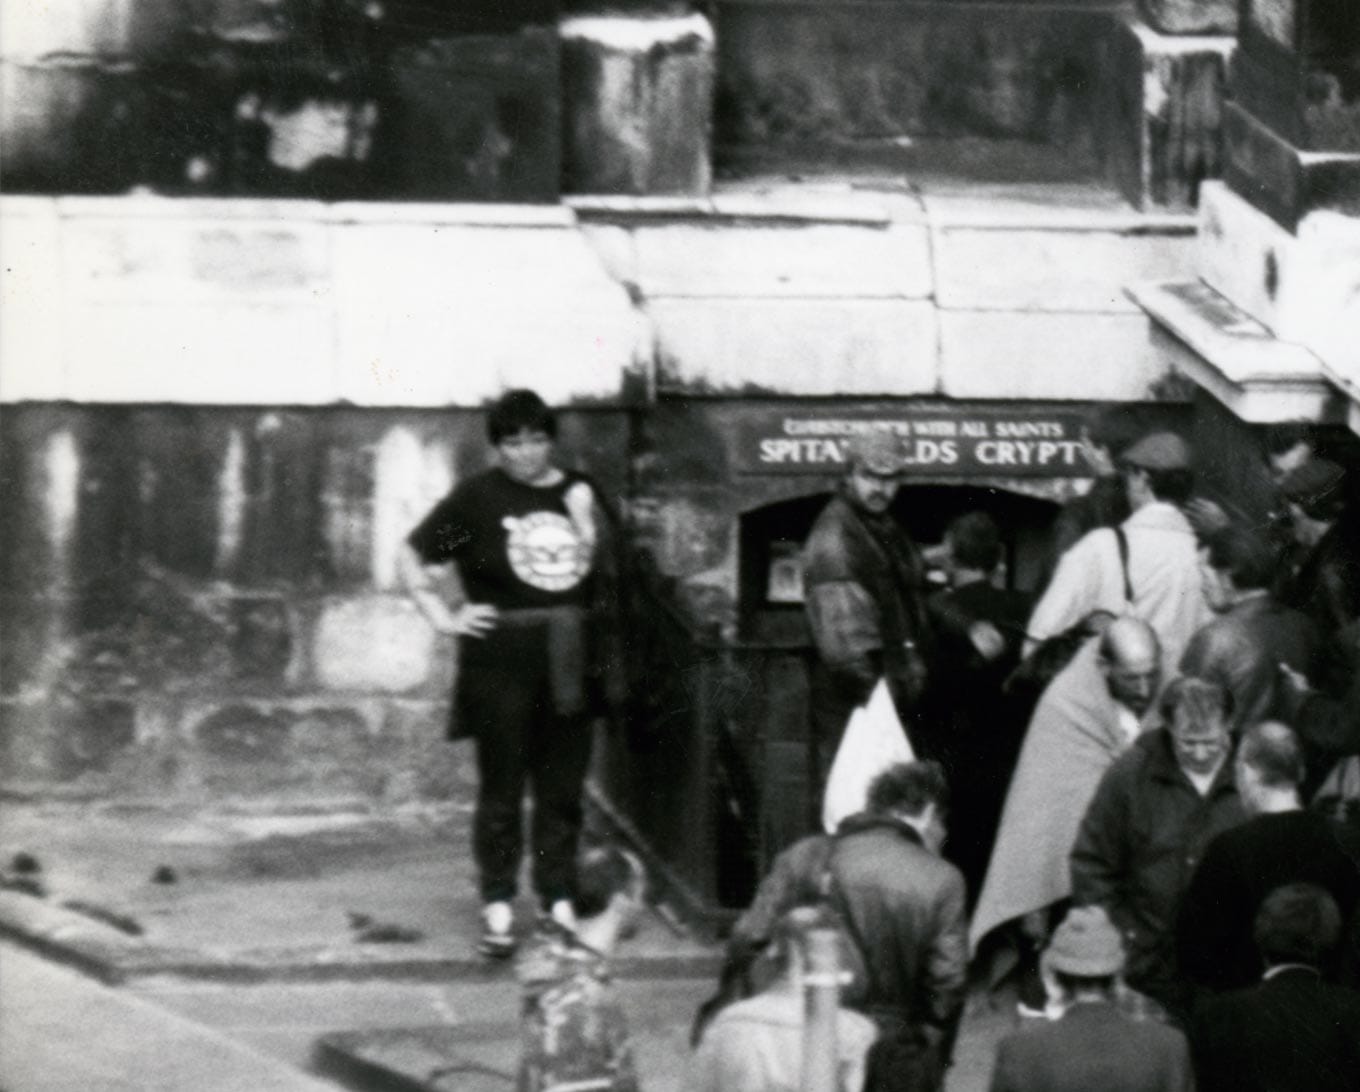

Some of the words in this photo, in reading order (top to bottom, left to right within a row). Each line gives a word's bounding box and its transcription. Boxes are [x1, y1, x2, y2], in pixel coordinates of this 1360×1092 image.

[960, 421, 989, 437] ALL
[995, 421, 1064, 437] SAINTS
[760, 438, 959, 465] SPITADS
[975, 440, 1084, 465] CRYPT
